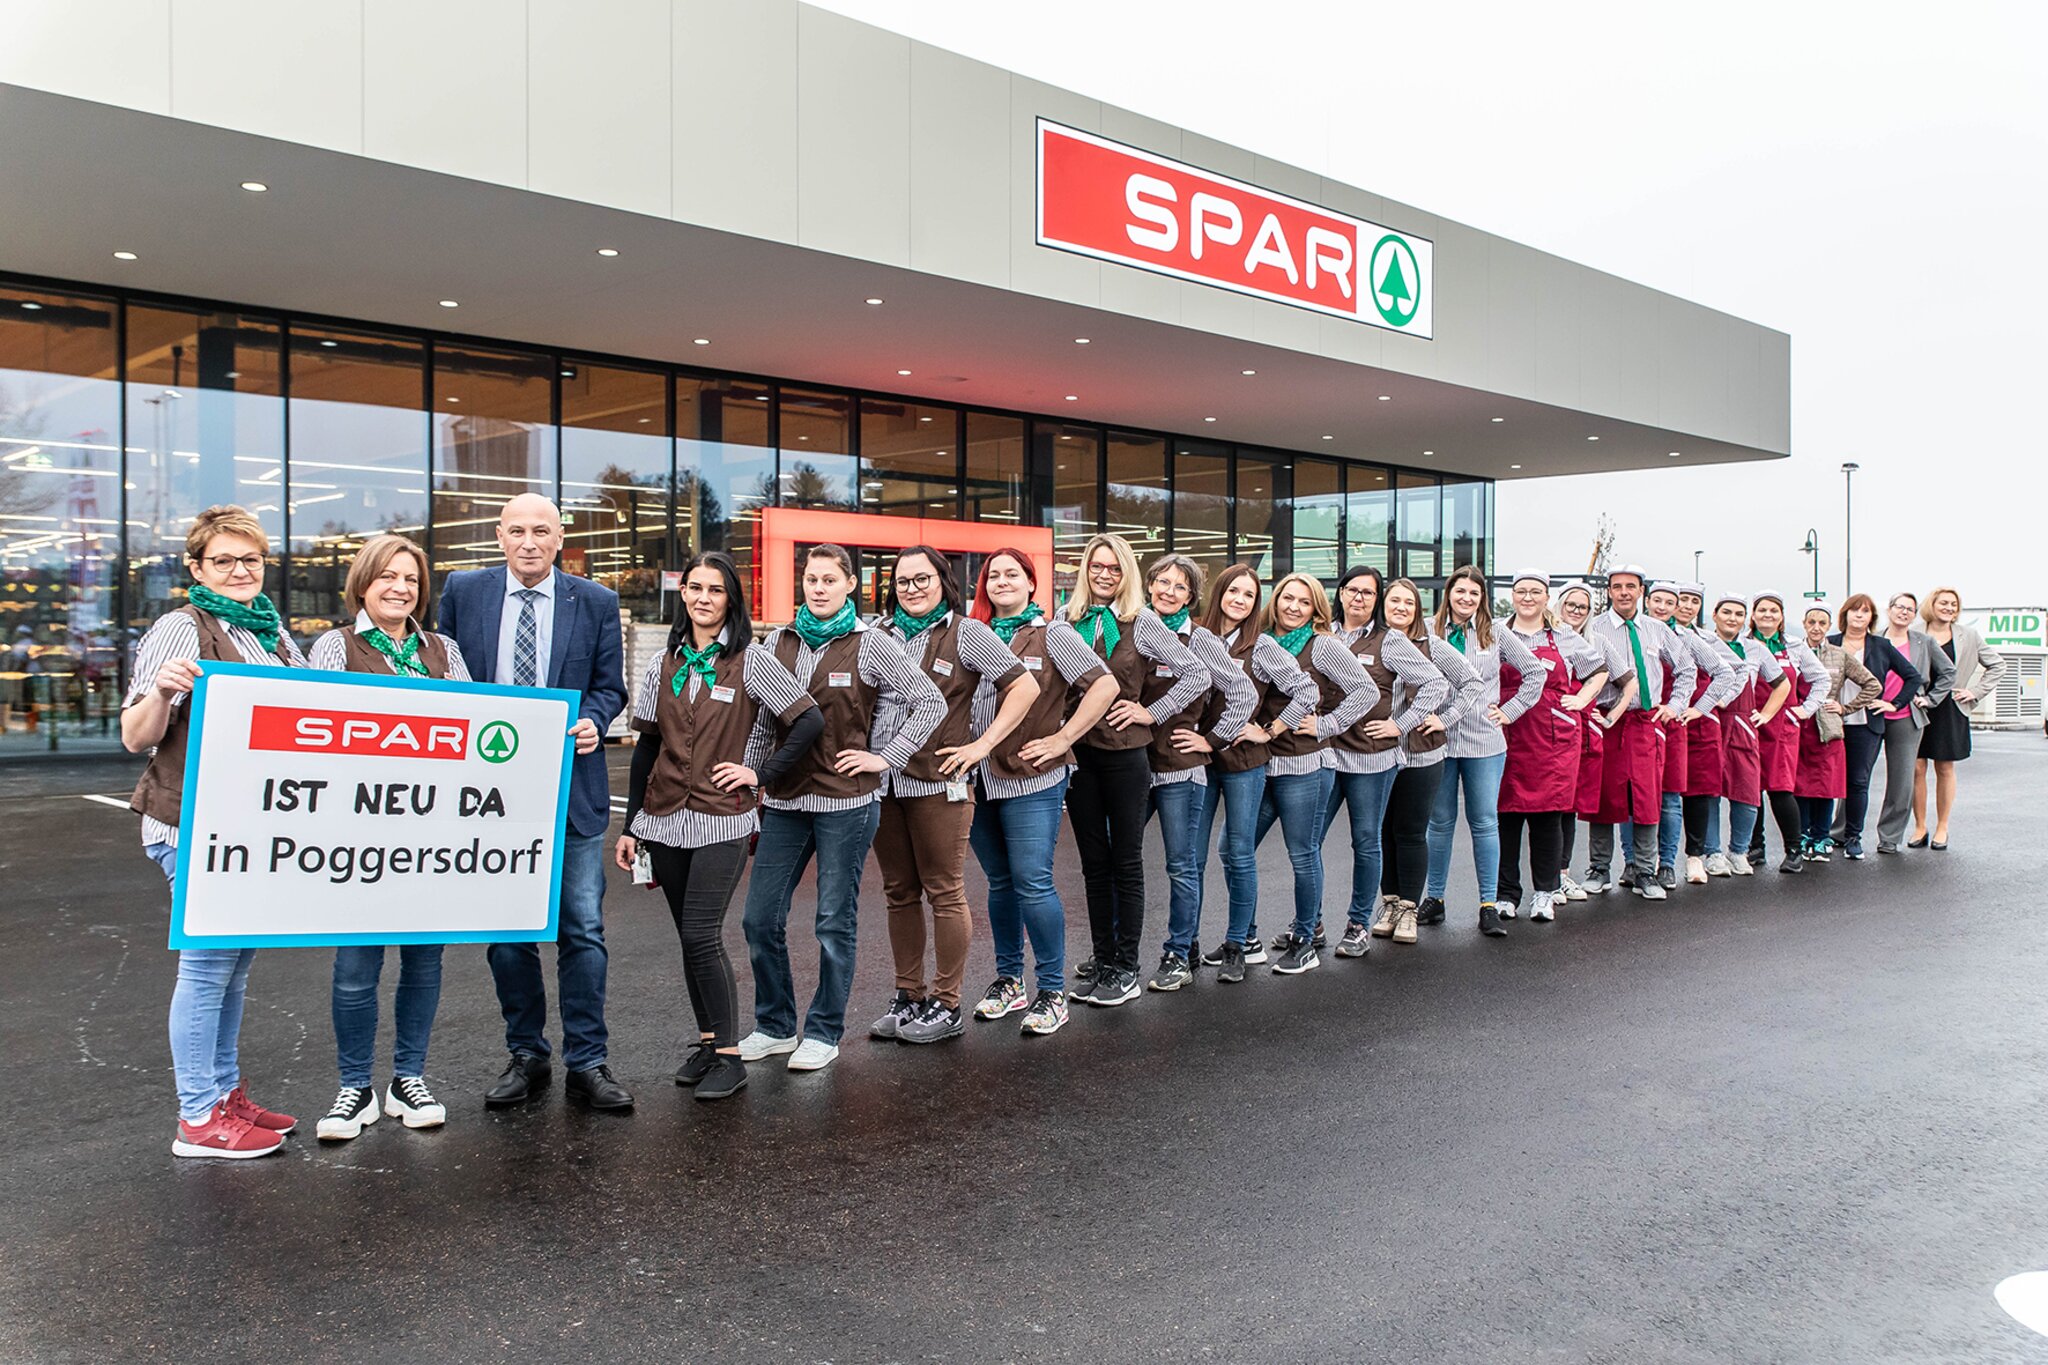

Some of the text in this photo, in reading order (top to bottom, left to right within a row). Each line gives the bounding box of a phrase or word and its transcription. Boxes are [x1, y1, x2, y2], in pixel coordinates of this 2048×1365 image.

[1125, 173, 1353, 298] SPAR
[1989, 615, 2040, 632] MID
[295, 717, 464, 753] SPAR
[262, 778, 506, 818] IST NEU DA
[206, 833, 543, 884] in Poggersdorf
